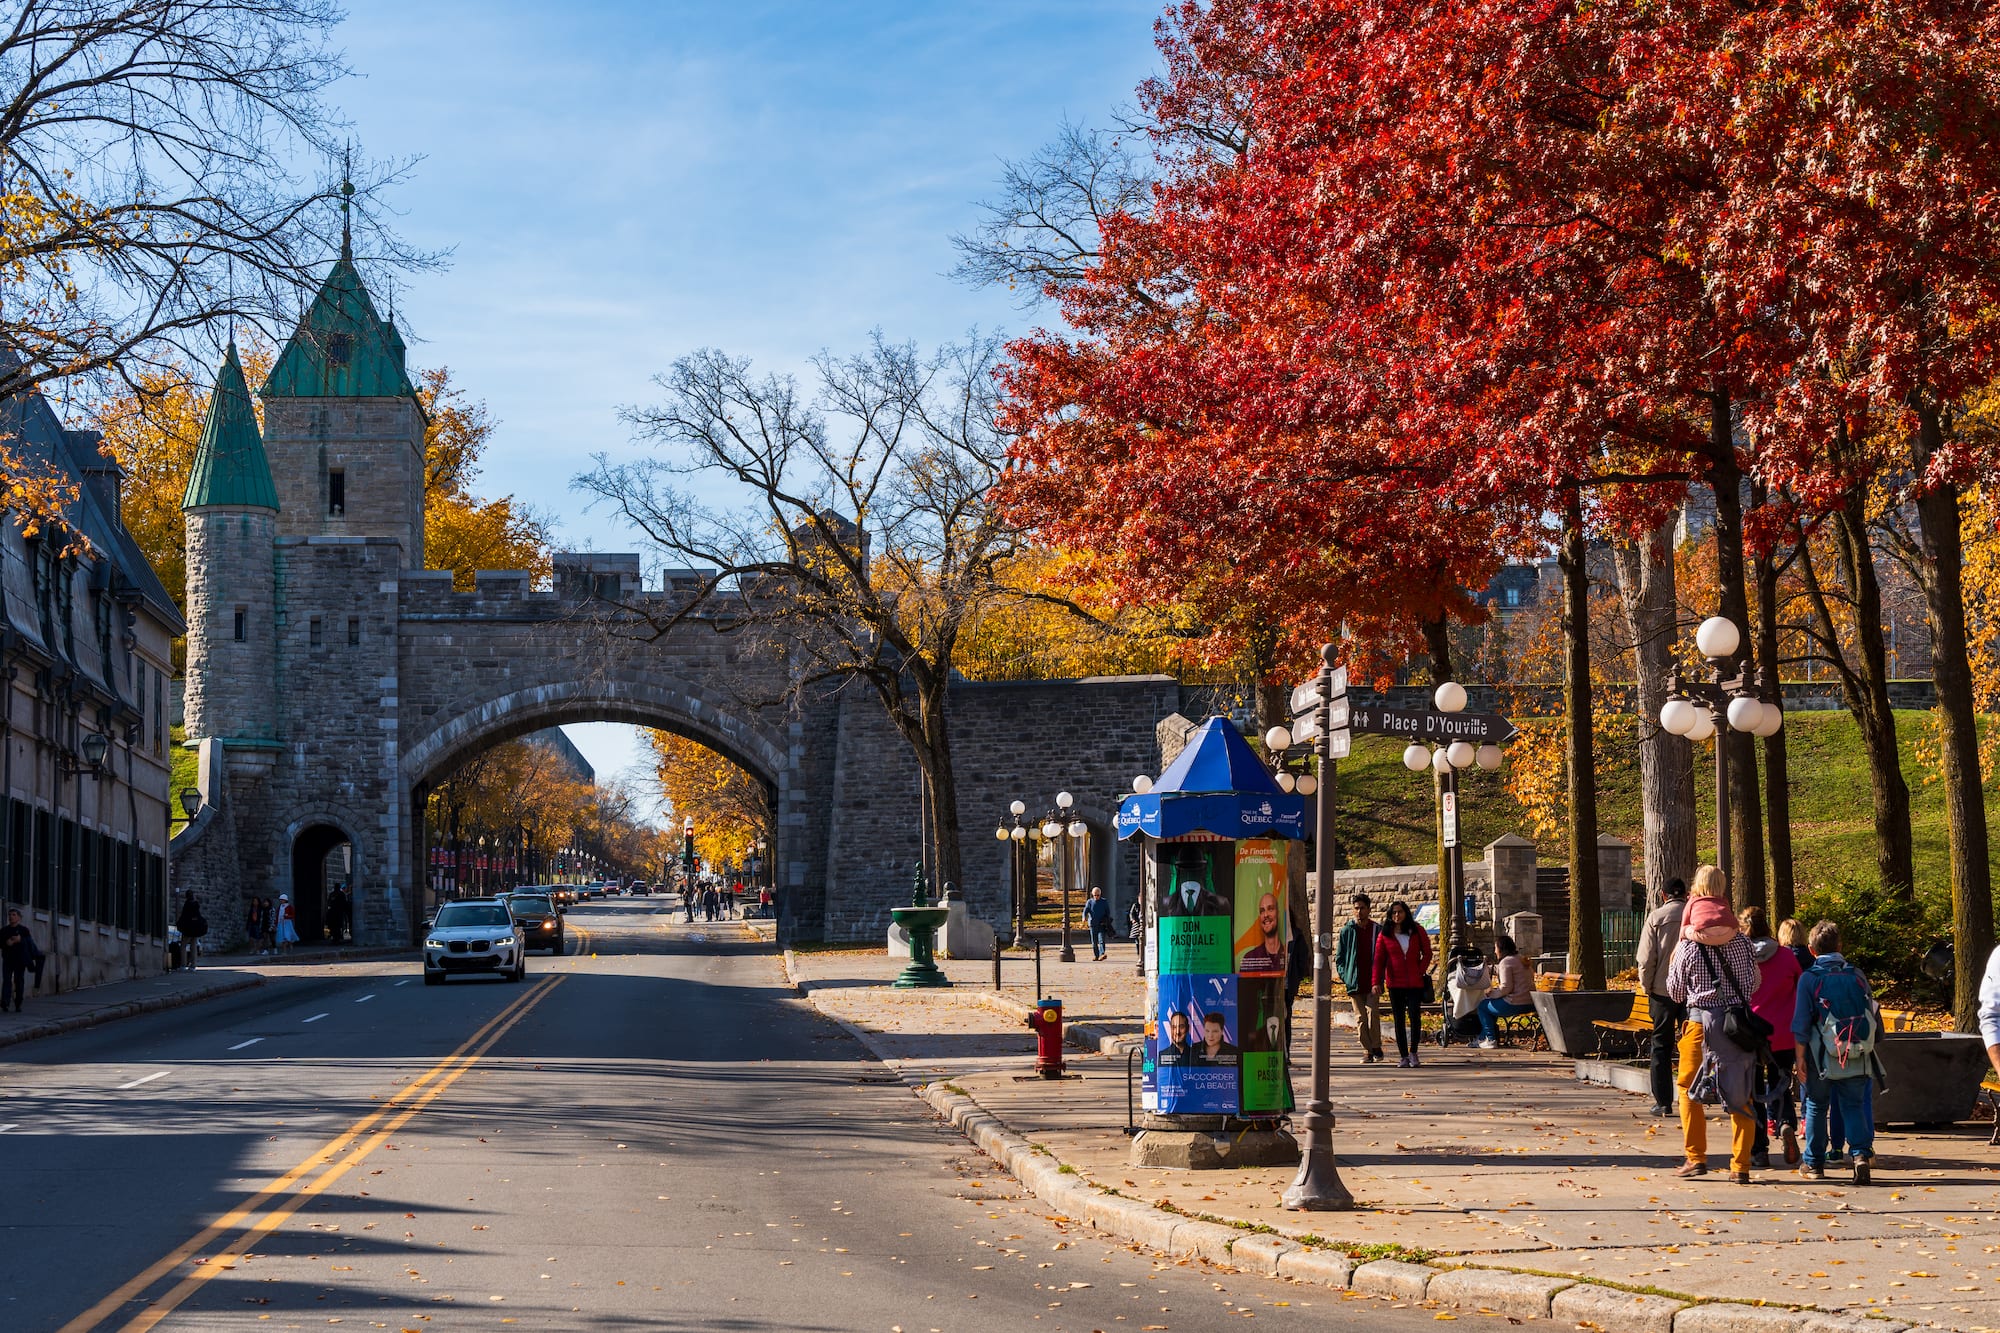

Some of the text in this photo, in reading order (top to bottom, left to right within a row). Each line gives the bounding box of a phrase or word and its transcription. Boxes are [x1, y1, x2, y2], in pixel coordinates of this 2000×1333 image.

[1383, 713, 1488, 736] Place D'Youville
[1241, 814, 1273, 825] QUÉBEC
[1240, 847, 1249, 855] De
[1183, 920, 1200, 933] DON
[1170, 934, 1215, 947] PASQUALE
[1195, 1082, 1205, 1090] LA
